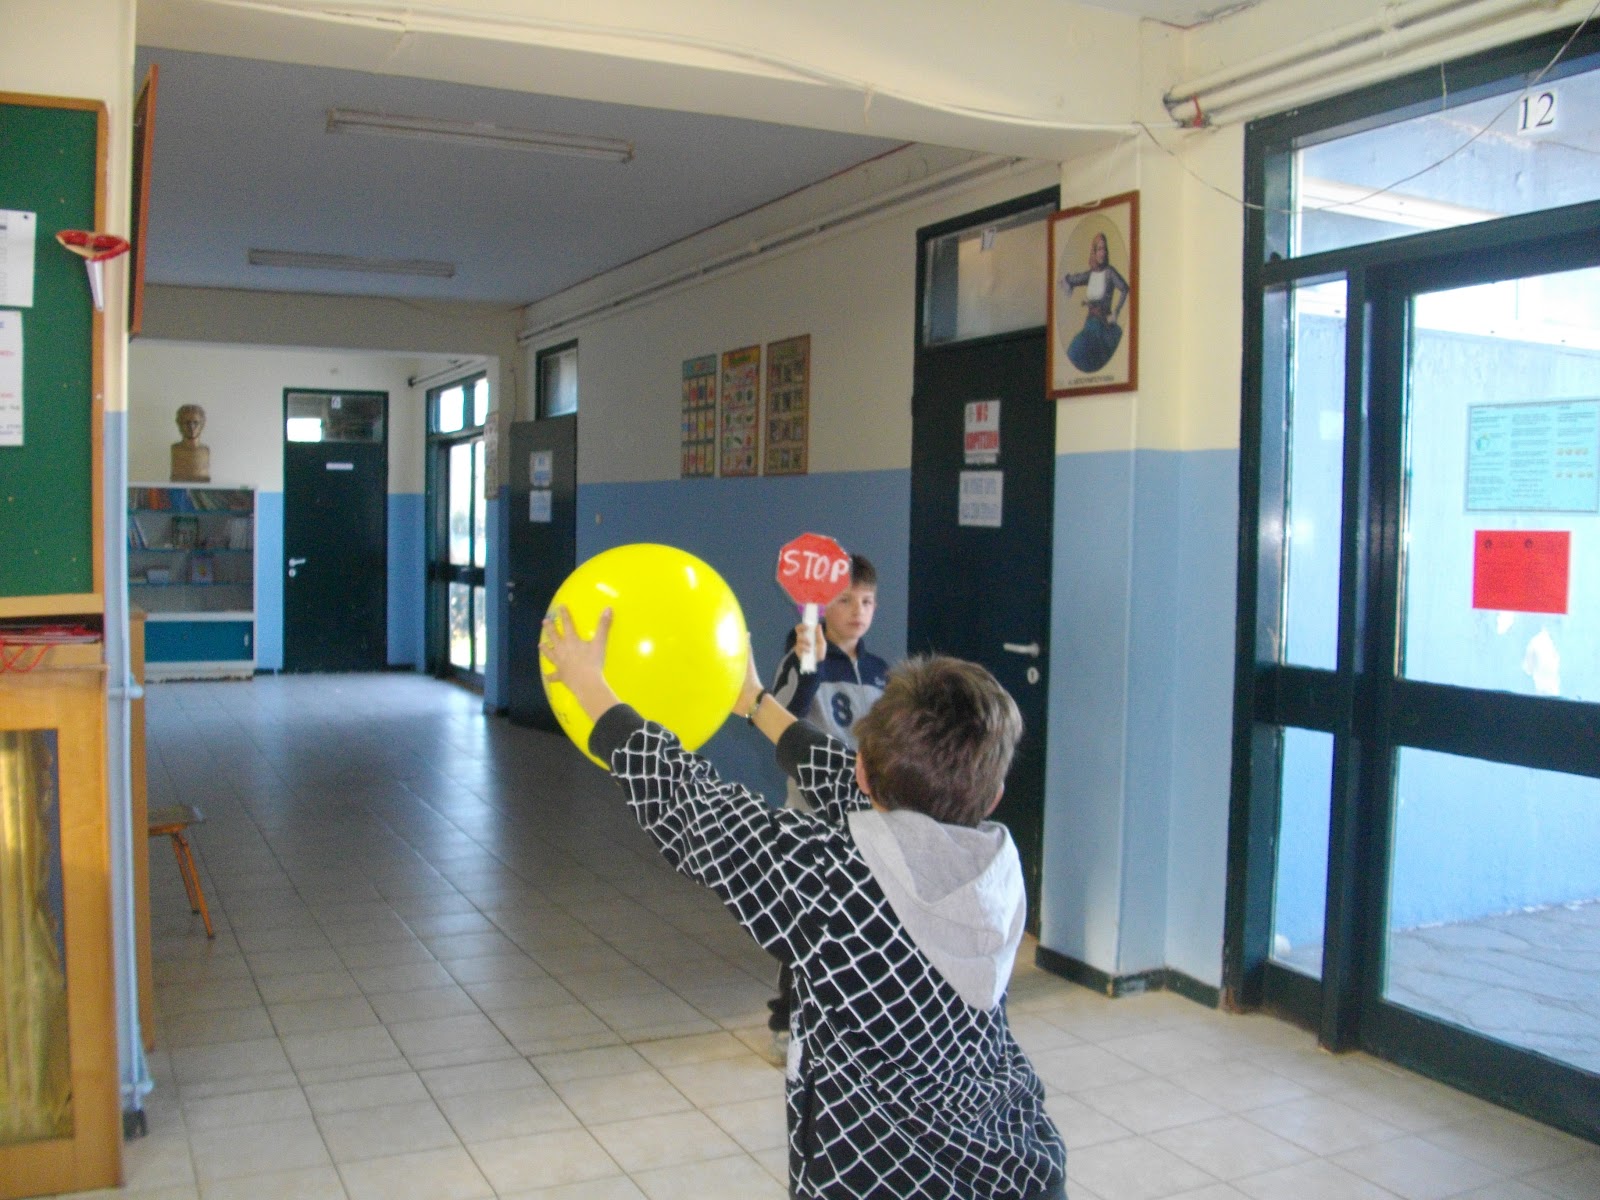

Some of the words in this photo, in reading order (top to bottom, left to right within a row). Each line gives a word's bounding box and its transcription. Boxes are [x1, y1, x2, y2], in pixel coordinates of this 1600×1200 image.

[1520, 92, 1554, 130] 12
[783, 550, 849, 583] STOP
[831, 692, 853, 728] 8
